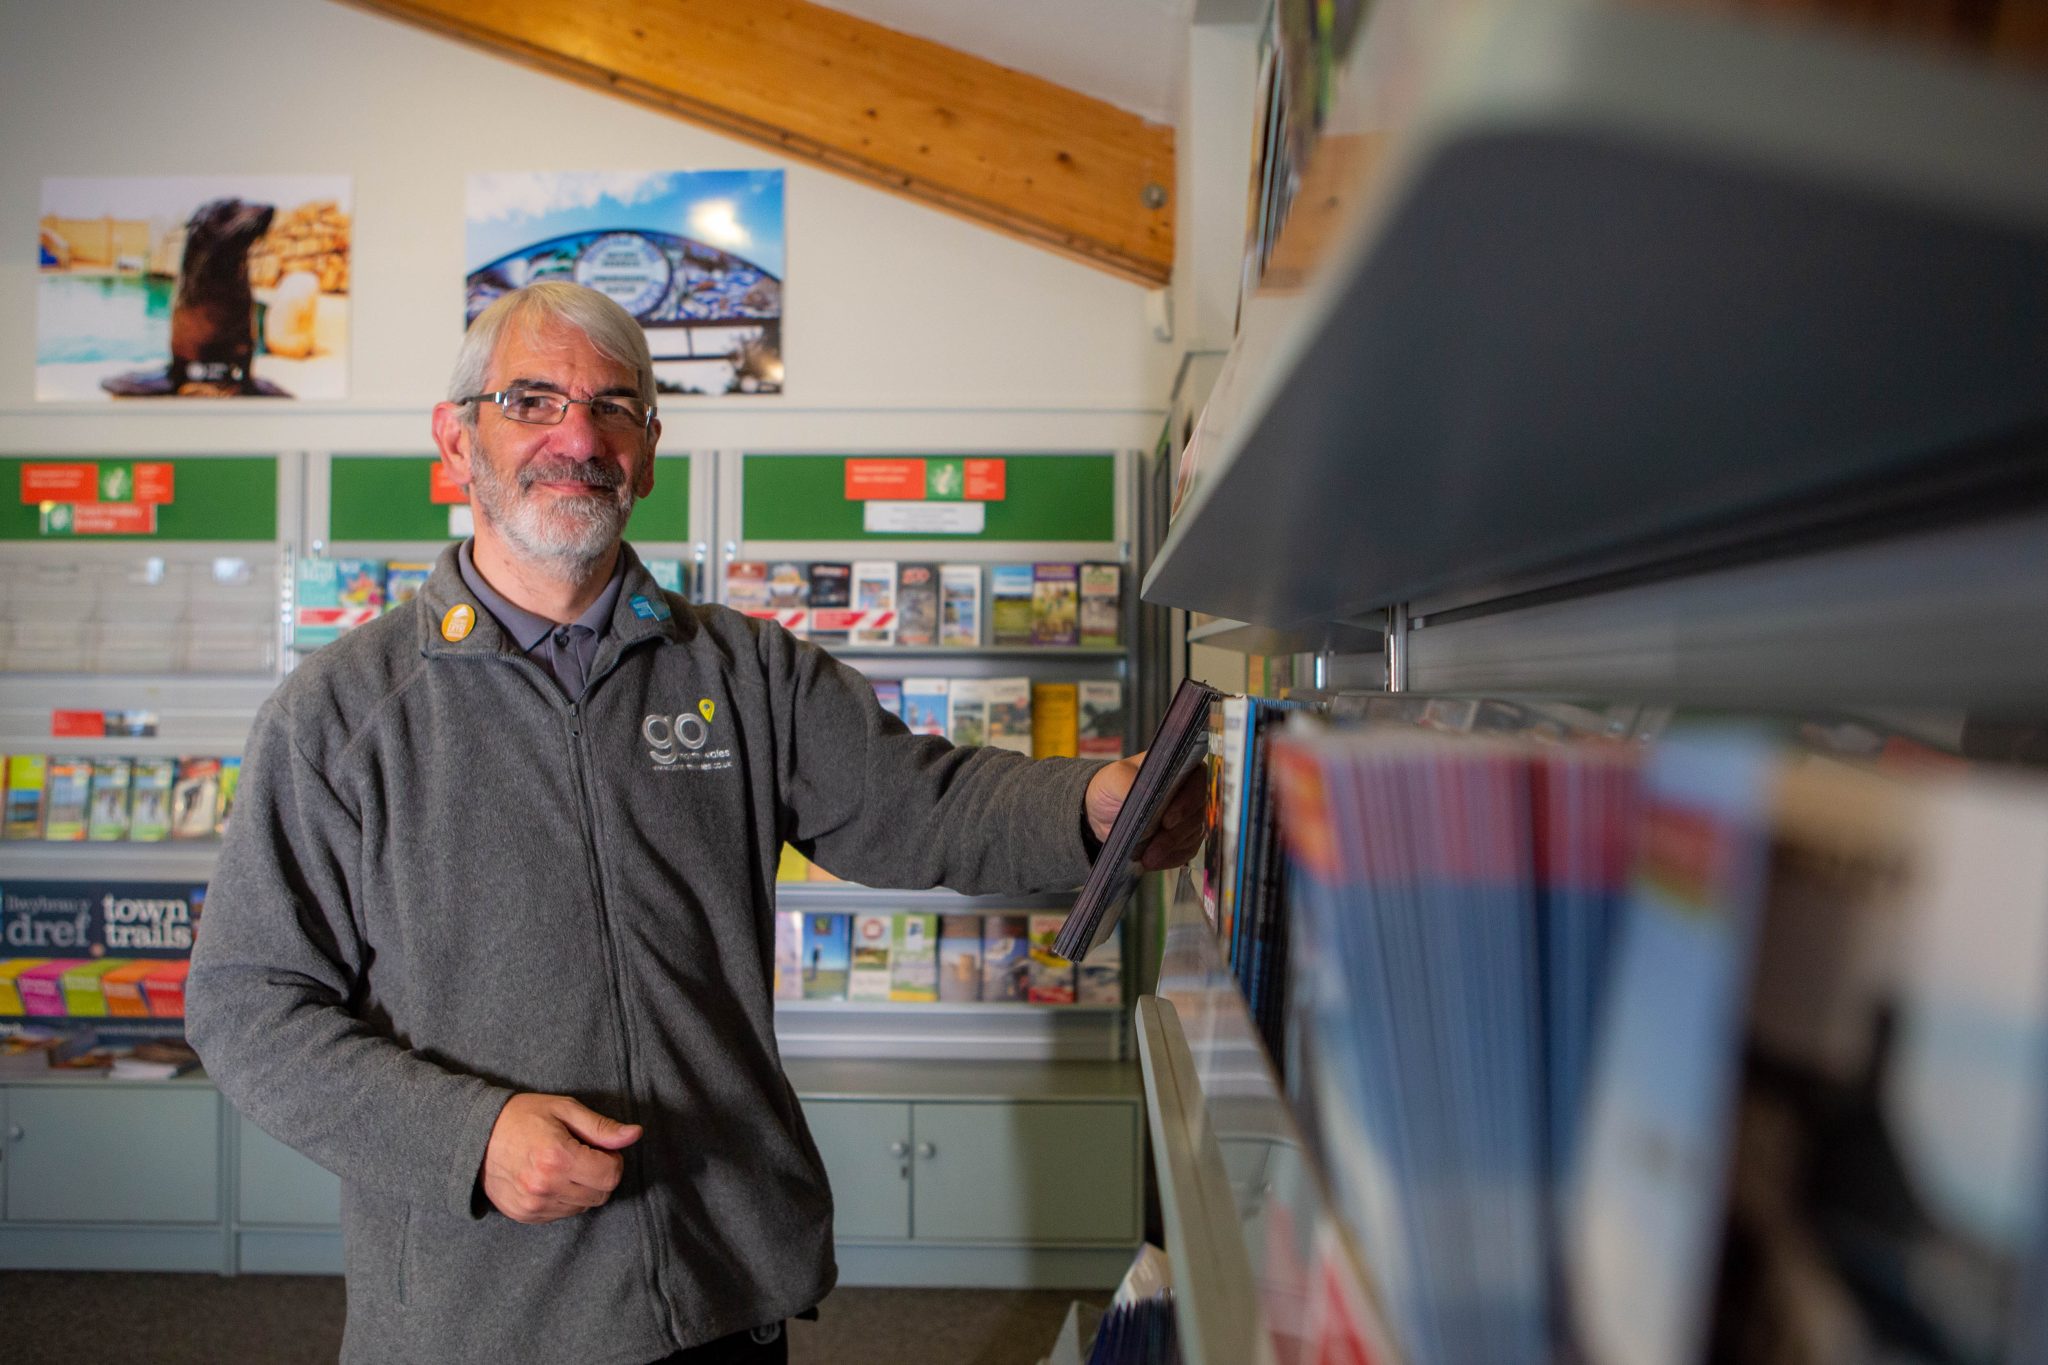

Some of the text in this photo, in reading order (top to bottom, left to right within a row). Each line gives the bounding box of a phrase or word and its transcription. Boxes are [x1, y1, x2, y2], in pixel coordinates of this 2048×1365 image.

[642, 713, 708, 765] go
[102, 894, 189, 923] town
[6, 912, 91, 947] dref
[104, 918, 193, 949] trails
